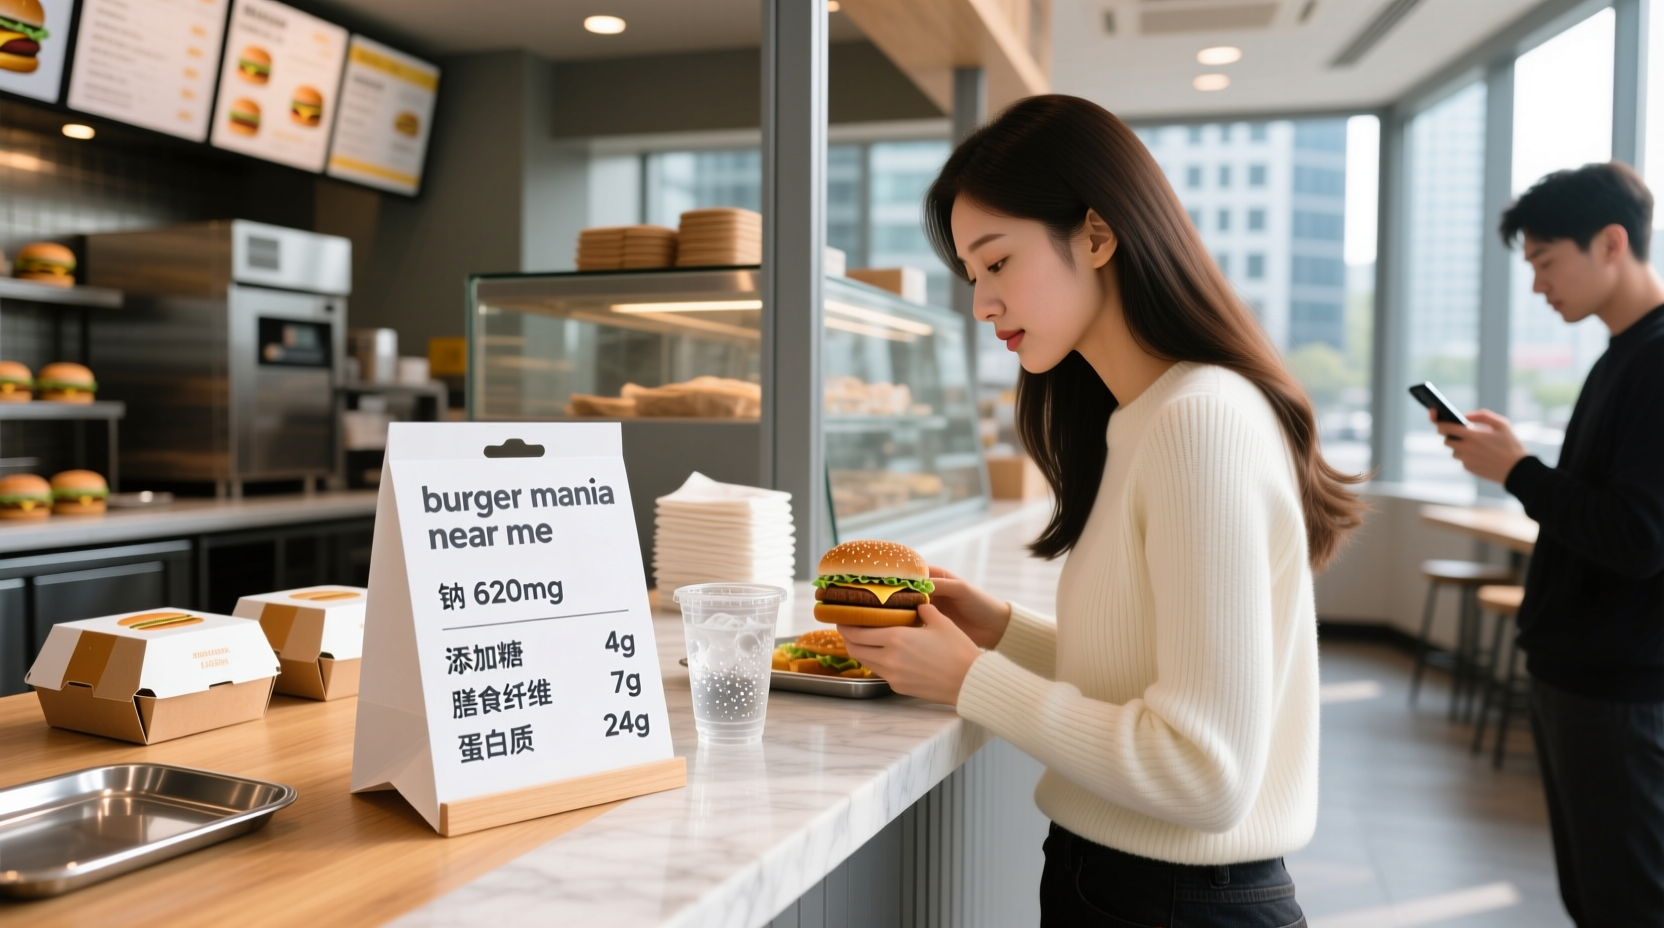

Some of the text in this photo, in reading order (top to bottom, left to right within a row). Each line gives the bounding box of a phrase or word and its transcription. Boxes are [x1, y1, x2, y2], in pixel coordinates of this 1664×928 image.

[421, 477, 615, 519] burger mania
[428, 522, 553, 550] near me
[438, 578, 564, 611] 钠 620mg
[445, 630, 636, 675] 添加糖 4g
[452, 670, 642, 719] 膳食纤维 7g
[457, 710, 650, 764] 蛋白质 24g
